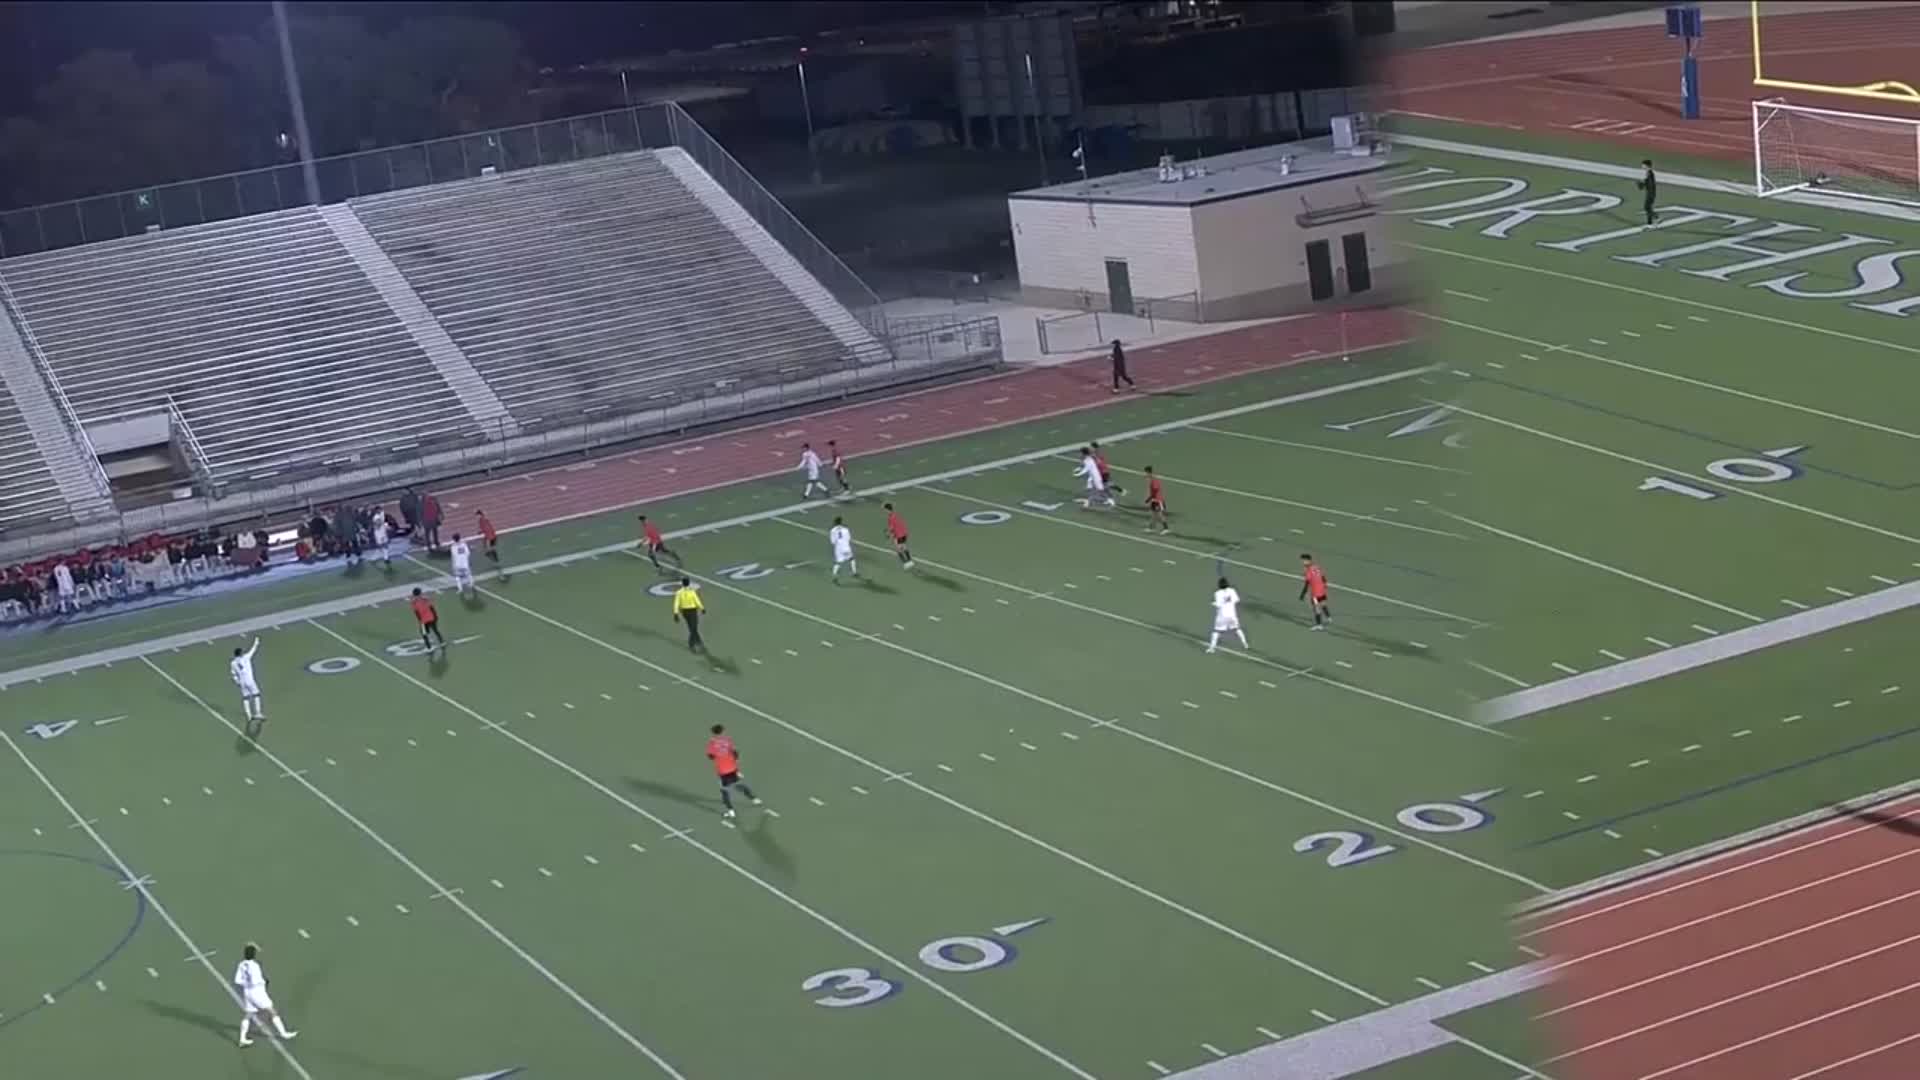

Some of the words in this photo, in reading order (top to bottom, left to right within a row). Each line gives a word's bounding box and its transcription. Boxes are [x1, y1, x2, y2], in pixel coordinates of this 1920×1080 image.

[1377, 166, 1920, 317] ORTHS
[1636, 457, 1794, 500] 10
[1293, 802, 1486, 867] 20
[802, 936, 1007, 1007] 30
